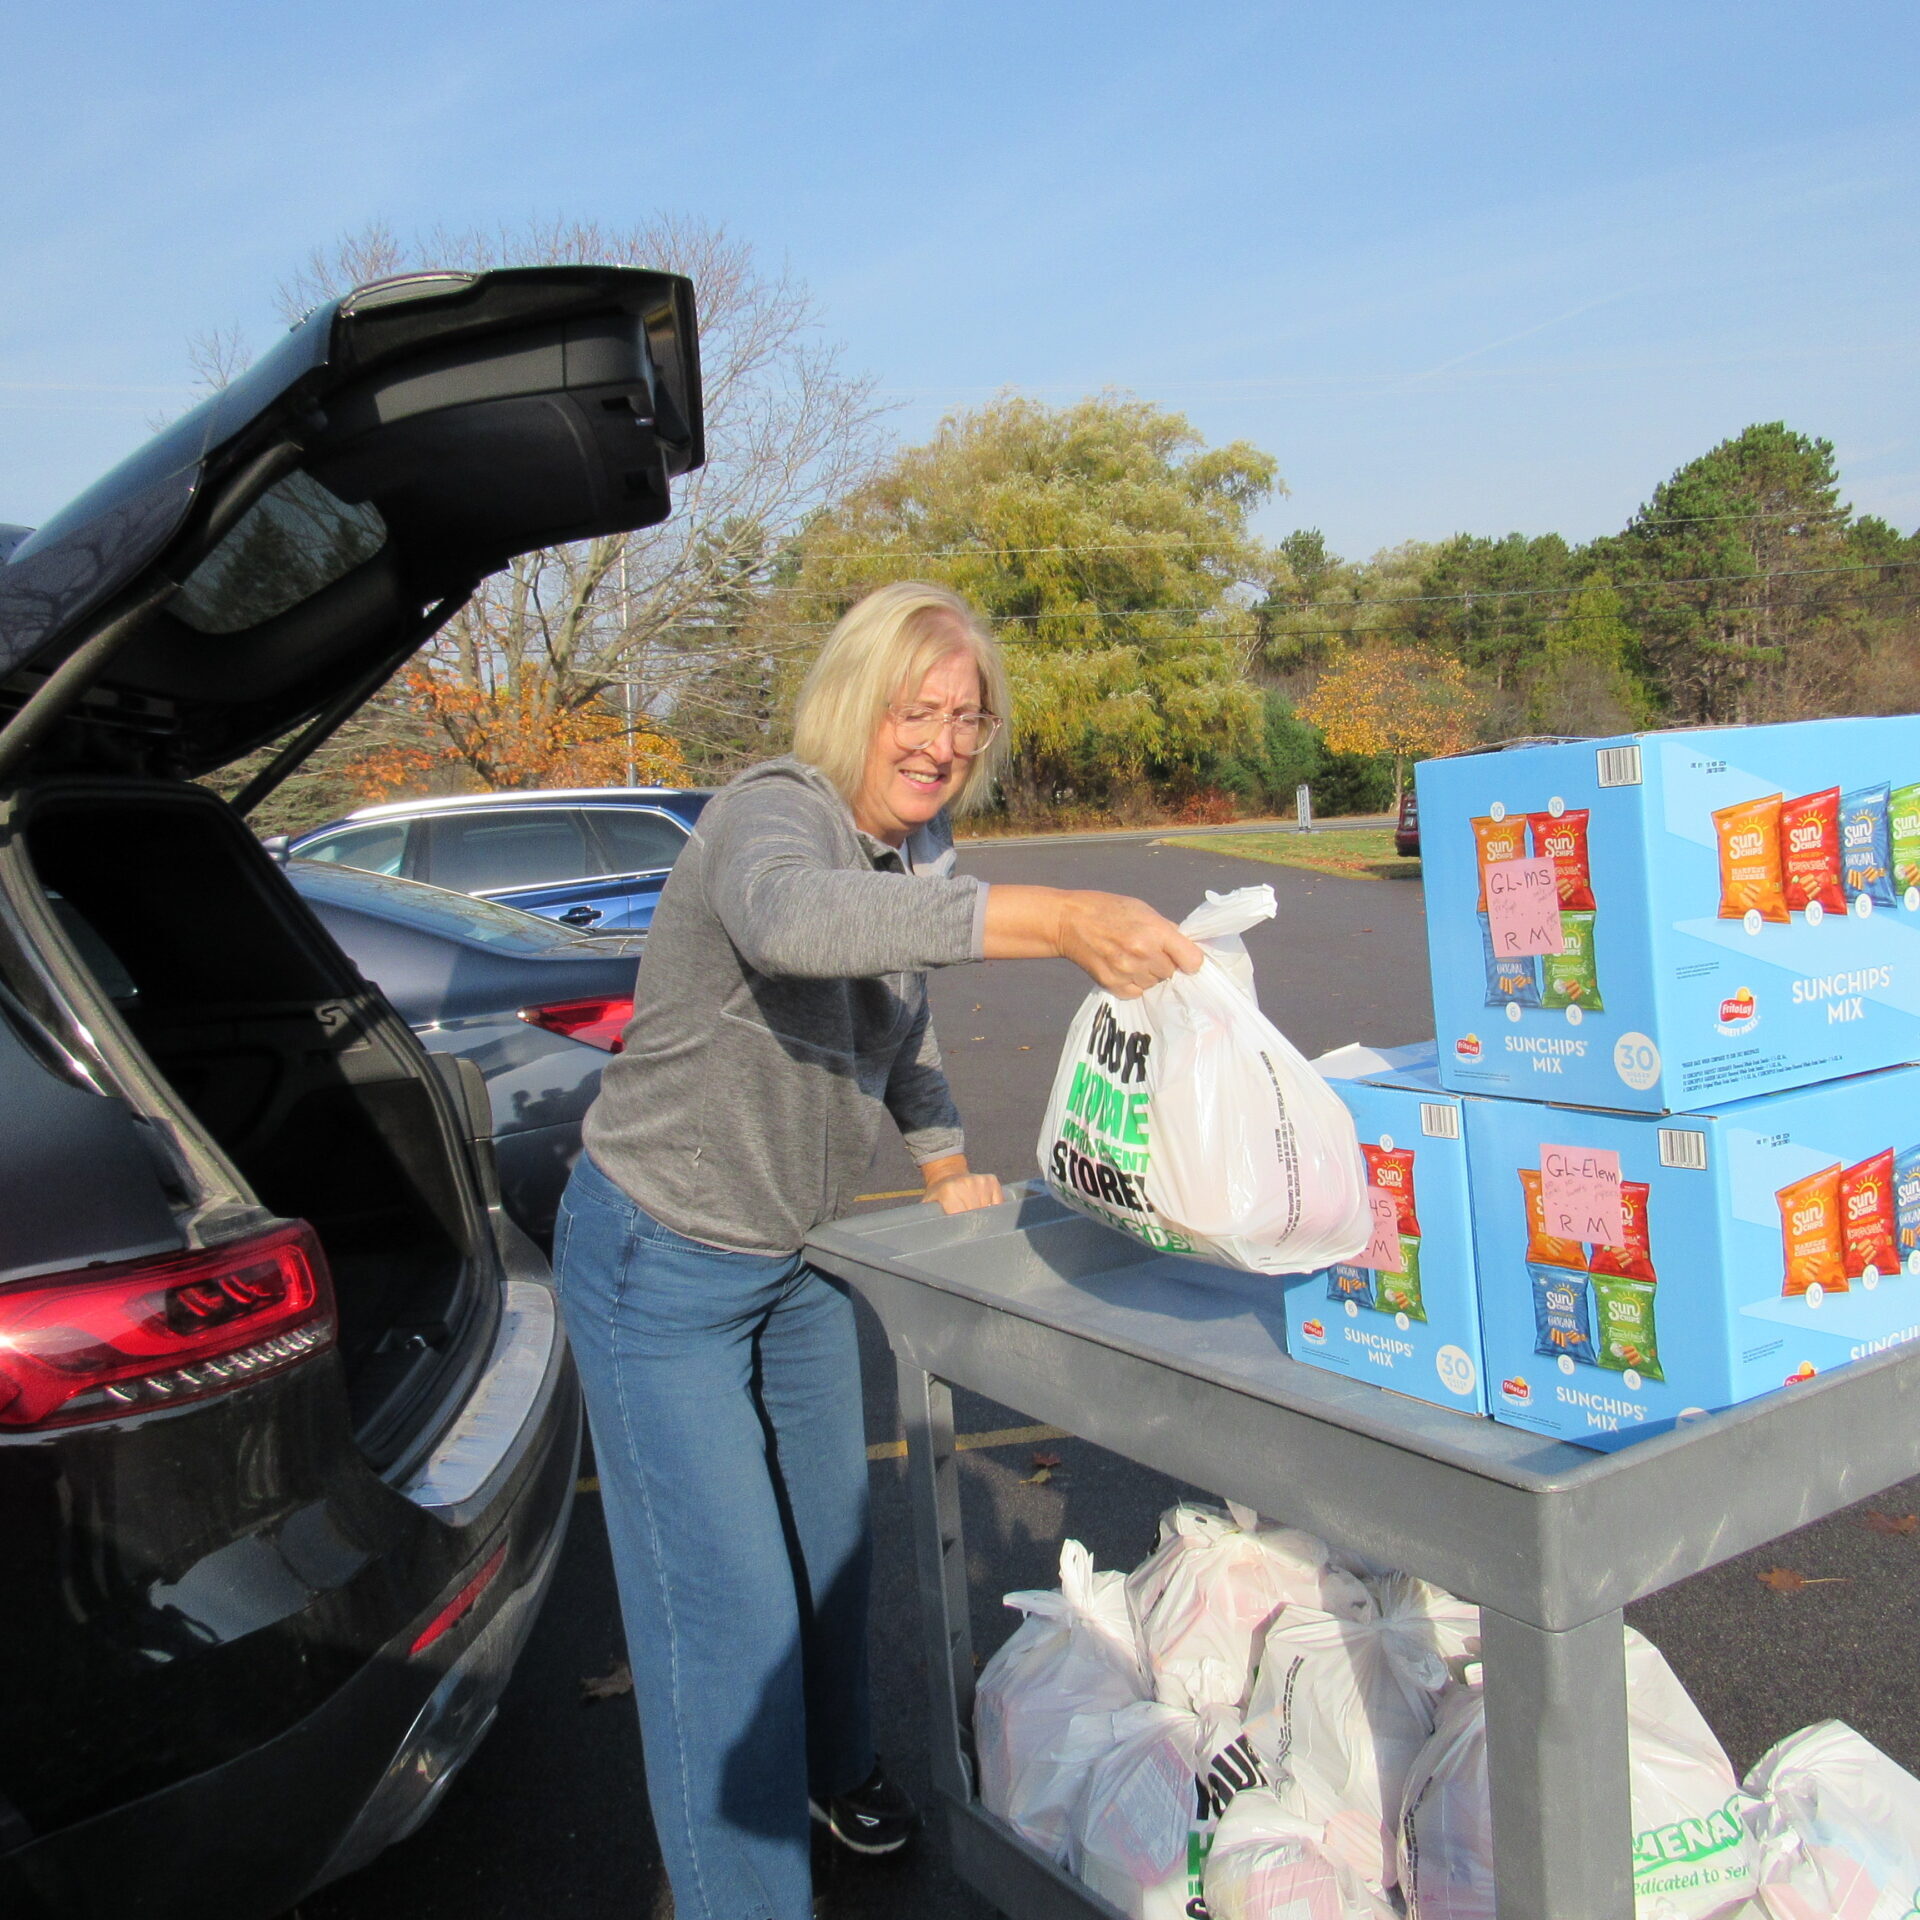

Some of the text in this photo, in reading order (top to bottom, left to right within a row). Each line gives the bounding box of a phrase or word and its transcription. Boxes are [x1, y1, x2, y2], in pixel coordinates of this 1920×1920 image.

[1545, 837, 1574, 857] Sun
[1729, 831, 1763, 859] Sun
[1789, 826, 1822, 853] Sun
[1800, 840, 1822, 849] CHIPS
[1844, 823, 1873, 847] Sun
[1487, 841, 1513, 861] Sun
[1740, 847, 1763, 857] CHIPS
[1792, 966, 1891, 1004] SUNCHIPS
[1828, 998, 1863, 1025] MIX
[1505, 1036, 1585, 1056] SUNCHIPS
[1619, 1045, 1654, 1071] 30
[1533, 1057, 1563, 1074] MIX
[1051, 1140, 1155, 1213] STORE!
[1377, 1167, 1403, 1187] Sun
[1848, 1192, 1878, 1220] Sun
[1792, 1206, 1824, 1235] Sun
[1802, 1219, 1824, 1232] CHIPS
[1546, 1291, 1574, 1309] Sun
[1608, 1300, 1640, 1320] Sun
[1344, 1328, 1413, 1357] SUNCHIPS
[1850, 1325, 1920, 1360] SUNCHI
[1368, 1350, 1394, 1368] MIX
[1441, 1353, 1470, 1380] 30
[1556, 1386, 1645, 1421] SUNCHIPS
[1587, 1412, 1619, 1432] MIX
[1634, 1870, 1699, 1897] edicated
[1704, 1866, 1720, 1885] to
